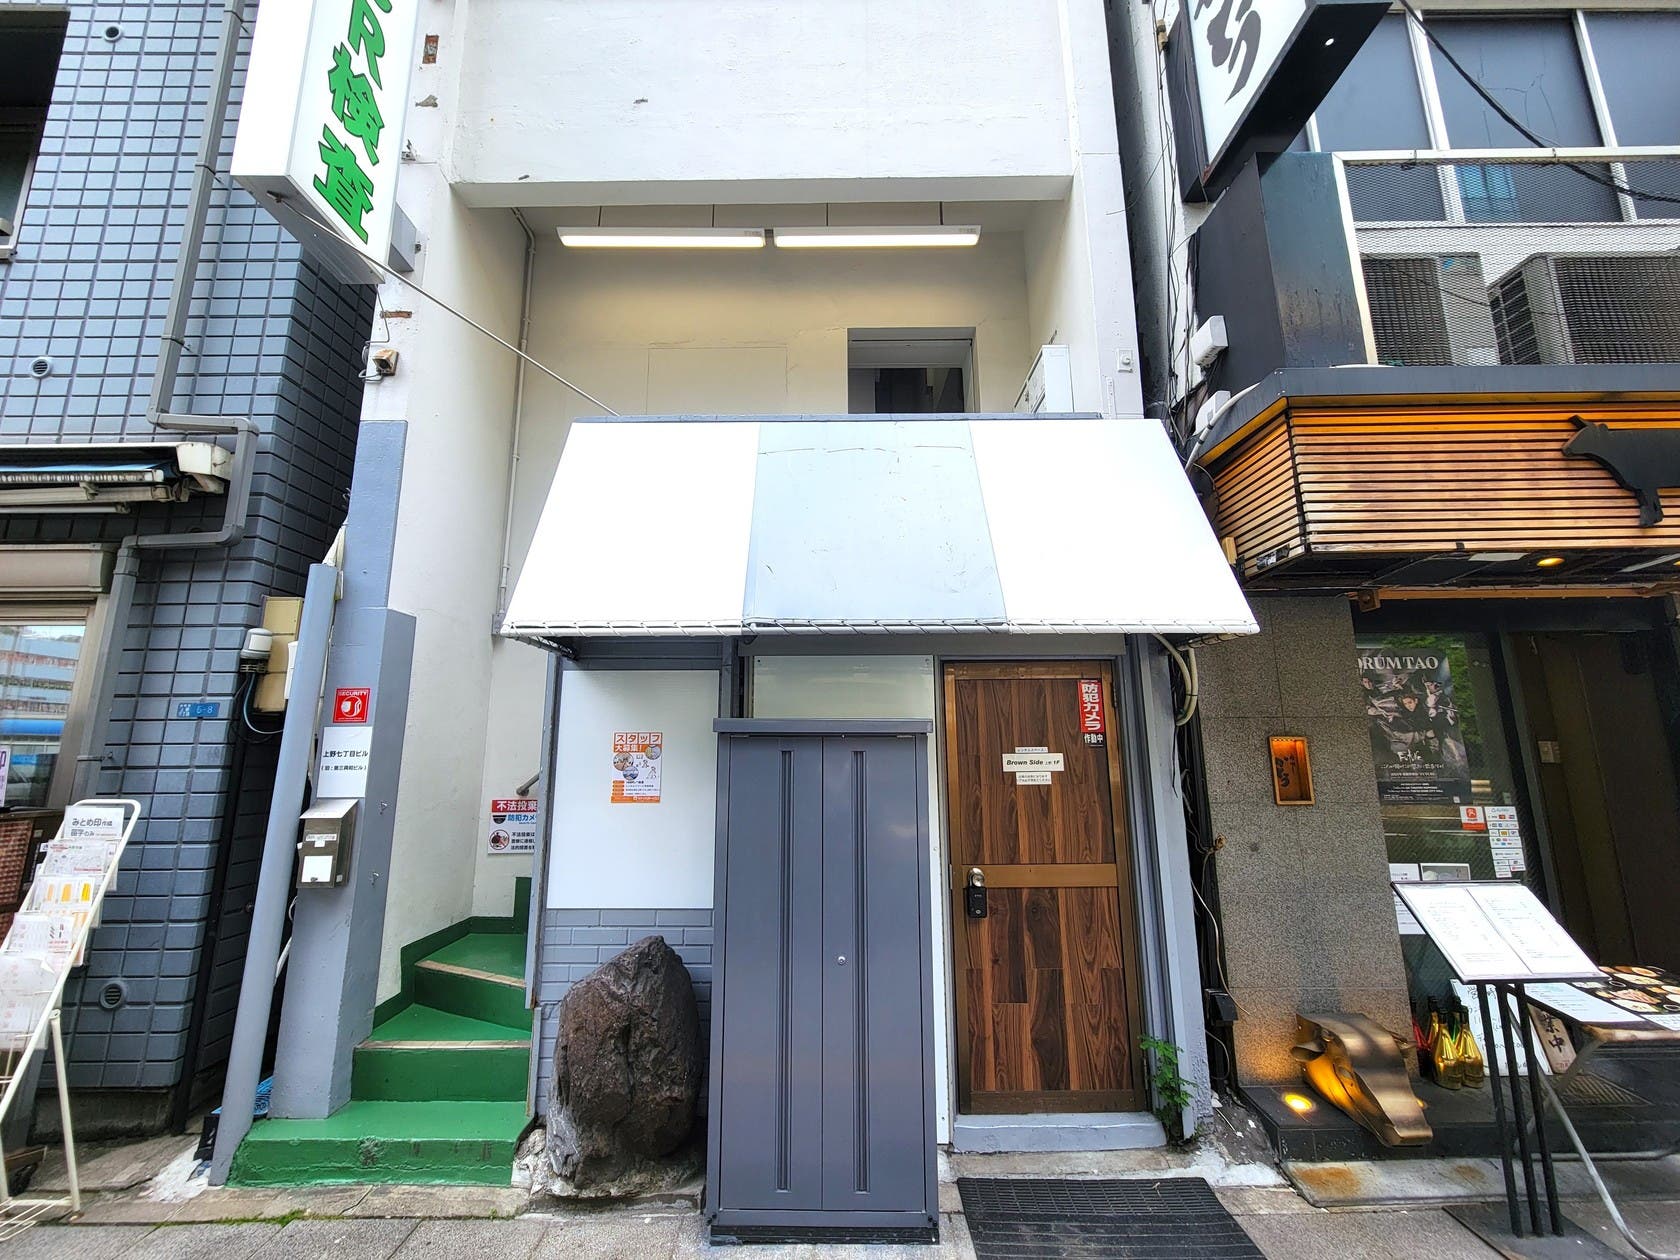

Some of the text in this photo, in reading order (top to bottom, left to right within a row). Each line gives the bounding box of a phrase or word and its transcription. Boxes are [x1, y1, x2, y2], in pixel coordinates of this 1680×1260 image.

[1402, 655, 1439, 670] TAO
[1081, 683, 1101, 731] 防犯カメラ
[615, 734, 661, 743] スタッフ
[1084, 733, 1104, 744] 作動中
[322, 750, 369, 758] 上野七丁目ビル
